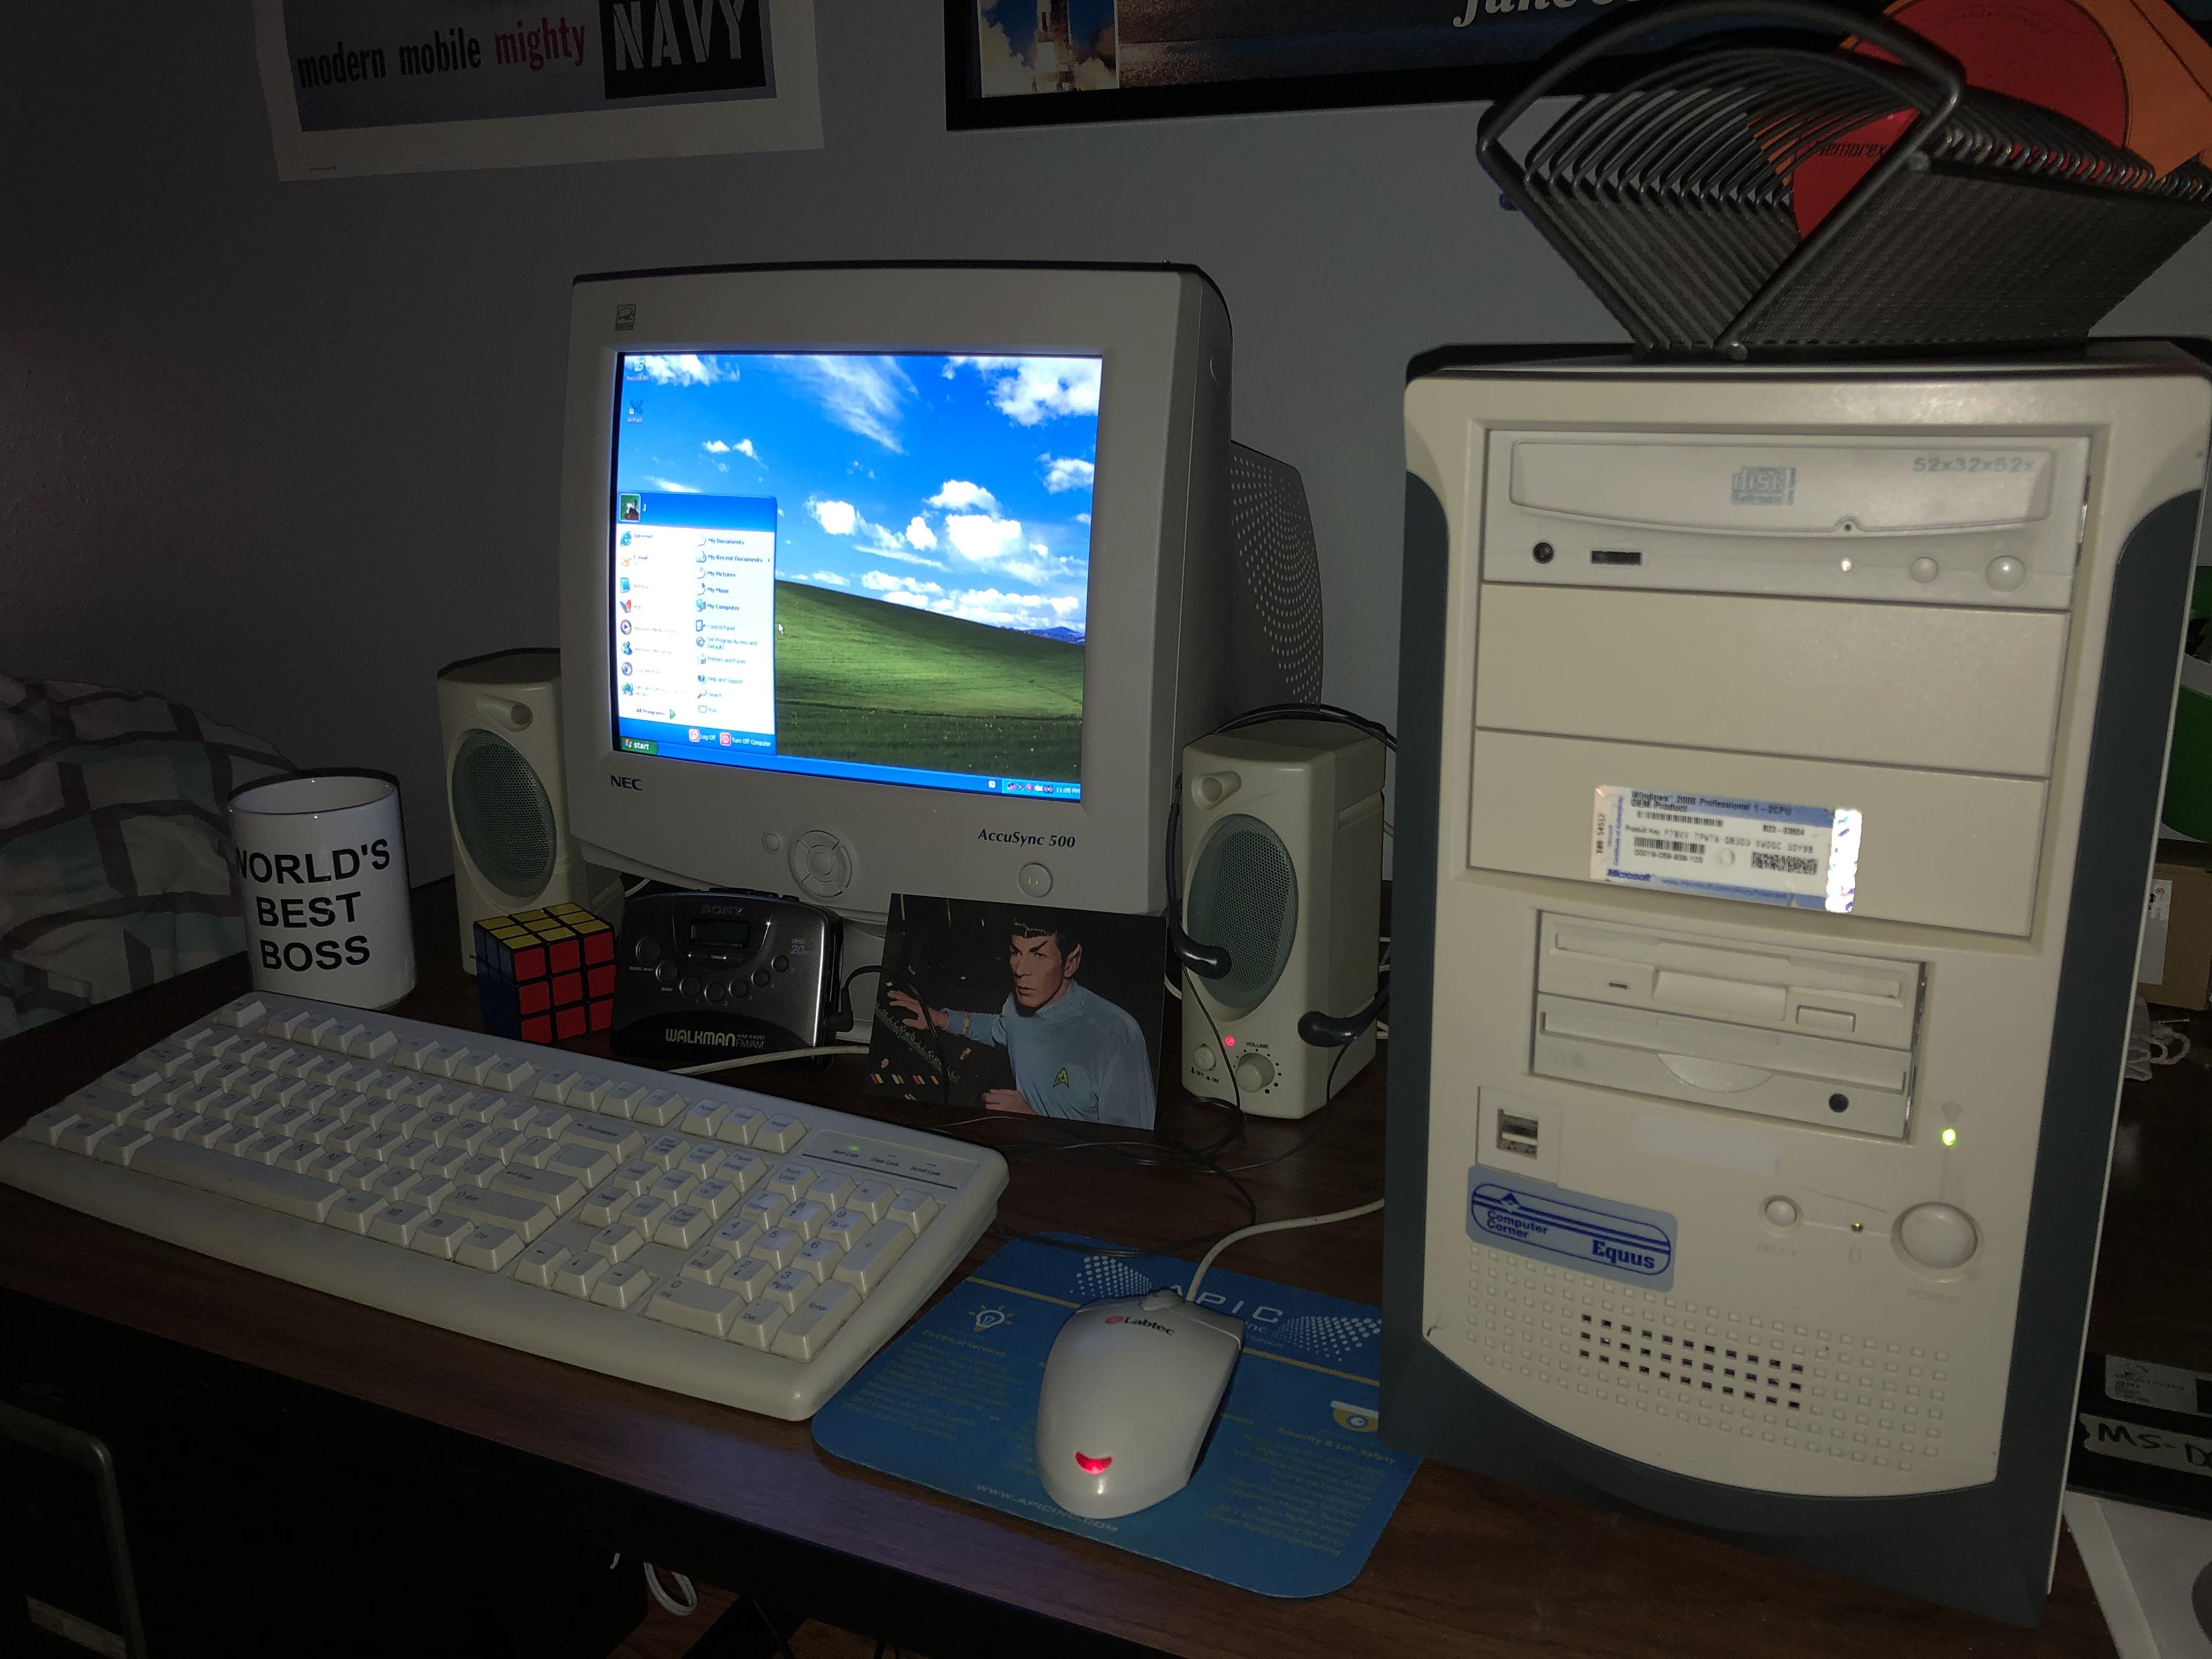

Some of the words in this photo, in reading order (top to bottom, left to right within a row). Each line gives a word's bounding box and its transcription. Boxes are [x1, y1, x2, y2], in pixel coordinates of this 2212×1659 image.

[613, 0, 745, 71] NAVY
[297, 41, 386, 88] modern
[399, 27, 481, 76] mobile
[495, 17, 585, 71] mighty
[1912, 456, 2035, 472] 52x32x52x
[634, 741, 650, 751] start
[611, 775, 642, 791] NEC
[978, 828, 1045, 847] AccuSync
[1049, 835, 1076, 848] 500
[256, 891, 361, 928] BEST
[701, 905, 744, 916] SONY
[259, 935, 370, 972] BOSS
[665, 1028, 736, 1047] WALKMAN
[736, 1039, 764, 1049] FM/AM
[1487, 1209, 1549, 1234] Computer
[1487, 1220, 1529, 1239] Corner
[810, 1241, 821, 1249] 6
[1592, 1239, 1655, 1270] Equus
[781, 1271, 792, 1279] 3
[1124, 1316, 1175, 1336] Labtec
